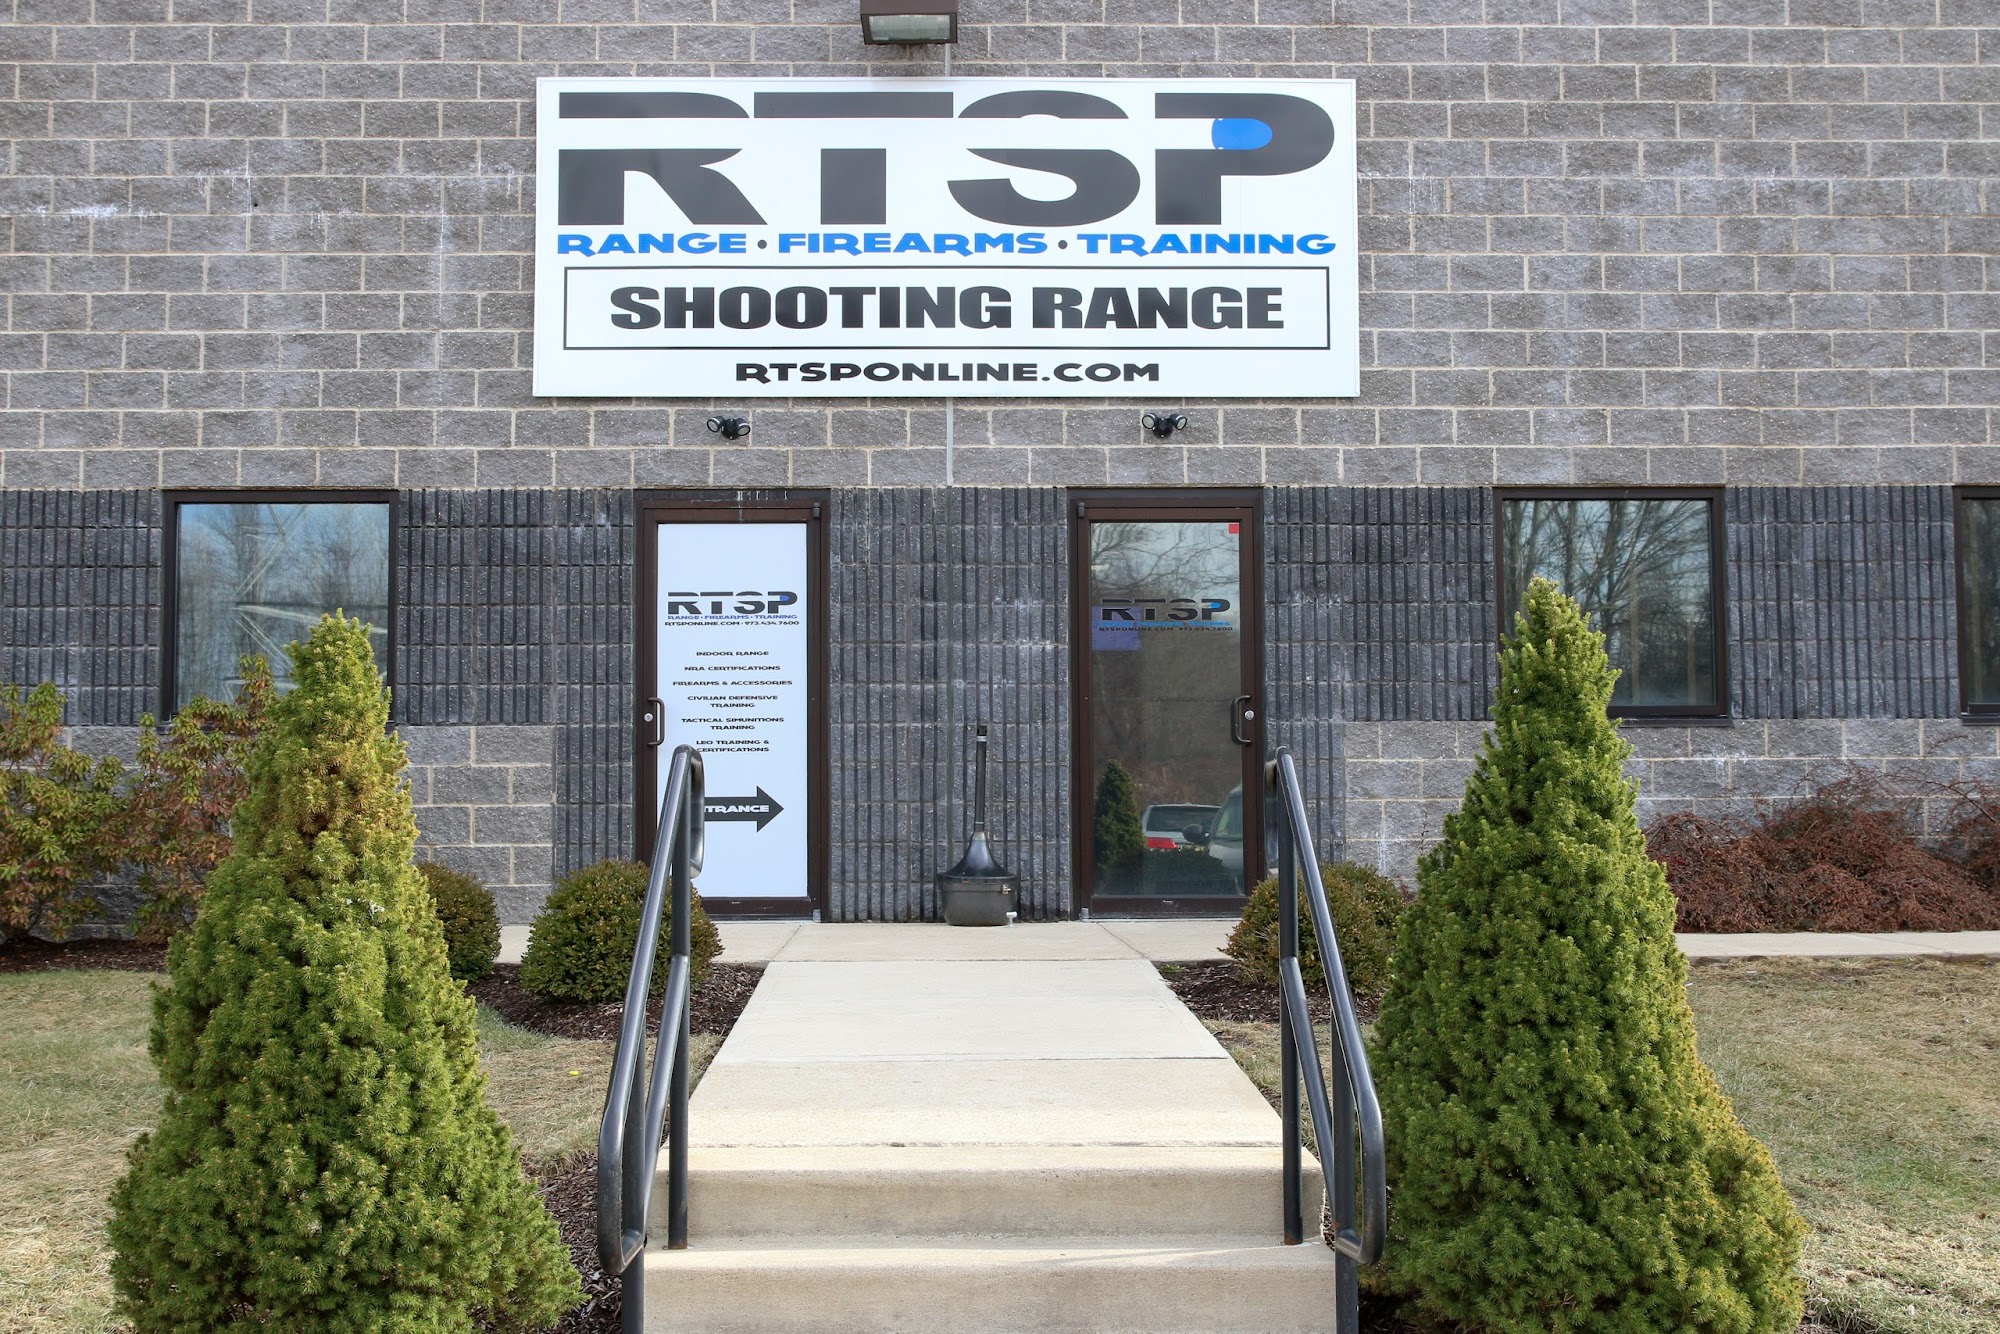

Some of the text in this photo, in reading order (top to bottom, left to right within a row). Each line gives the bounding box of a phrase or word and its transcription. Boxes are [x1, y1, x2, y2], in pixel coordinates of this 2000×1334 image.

[557, 90, 1335, 227] RTSP
[557, 232, 1337, 258] RANGE FIREARMS TRAINING
[610, 285, 1284, 330] SHOOTING RANGE
[736, 361, 1159, 385] RTSPONLINE.COM
[668, 591, 798, 614] RTSP
[1101, 598, 1231, 621] RTSP
[704, 805, 770, 813] TRANCE
